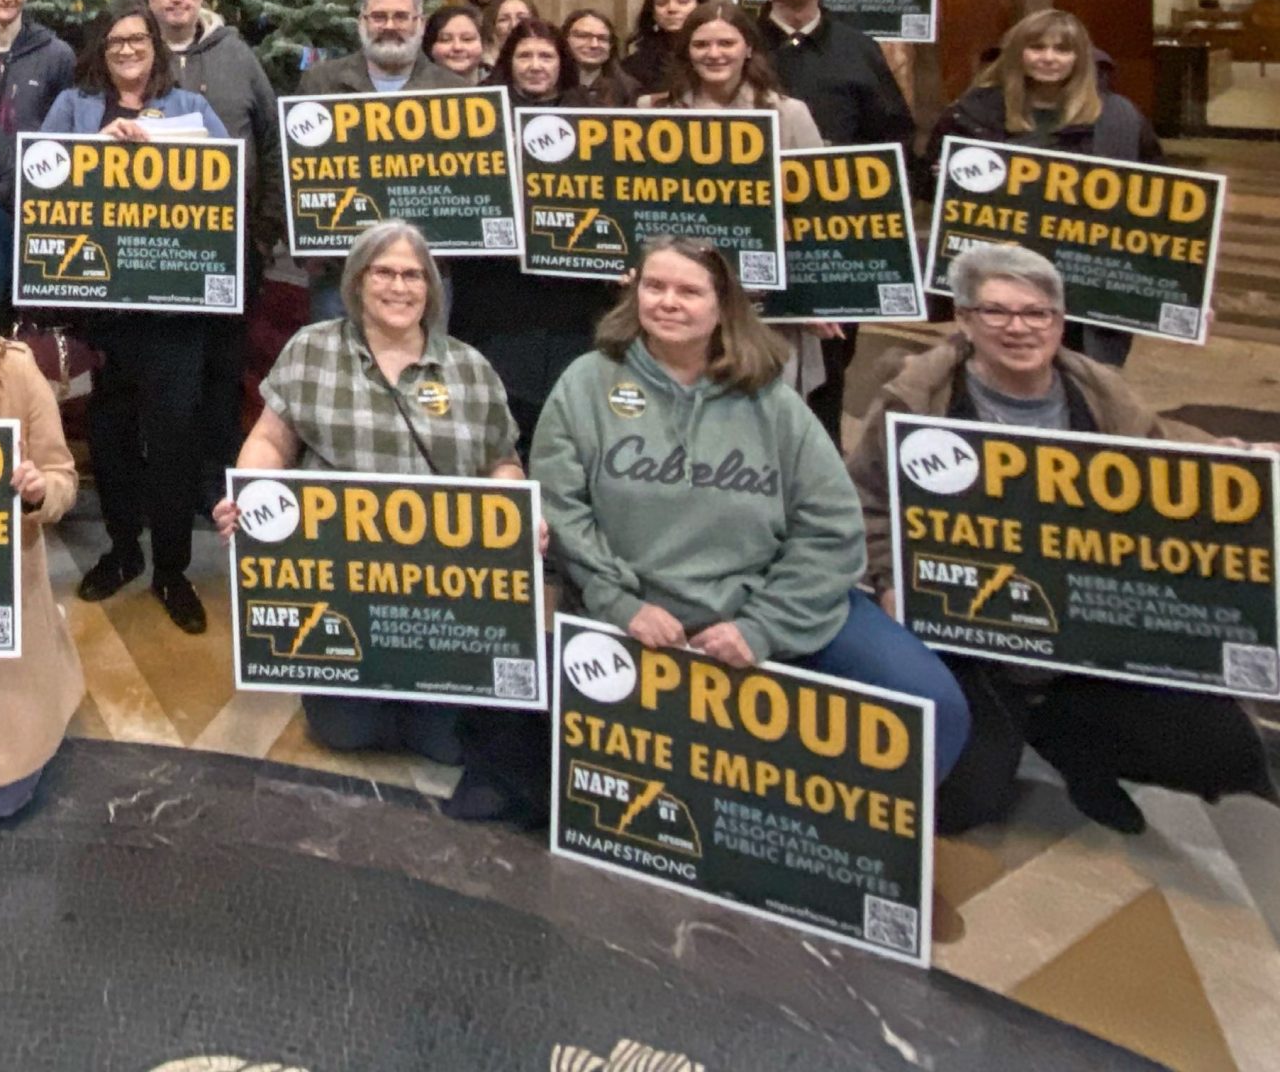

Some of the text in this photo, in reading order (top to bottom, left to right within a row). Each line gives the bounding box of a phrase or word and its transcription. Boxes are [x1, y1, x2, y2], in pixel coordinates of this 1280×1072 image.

[290, 112, 330, 140] I'M A
[334, 97, 497, 143] PROUD
[527, 126, 572, 154] I'M A
[578, 119, 765, 165] PROUD
[26, 152, 68, 180] I'M A
[73, 145, 231, 191] PROUD
[291, 151, 506, 181] STATE EMPLOYEE
[782, 156, 892, 203] OUD
[989, 159, 1003, 173] A
[526, 172, 771, 206] STATE EMPLOYEE
[1007, 156, 1208, 223] PROUD
[23, 199, 234, 231] STATE EMPLOYEE
[535, 211, 575, 228] NAPE
[785, 214, 905, 242] PLOYEE
[944, 198, 1207, 264] STATE EMPLOYEE
[29, 238, 65, 255] NAPE
[117, 236, 180, 248] NEBRASKA
[117, 248, 217, 261] ASSOCIATION OF
[117, 259, 157, 270] PUBLIC
[531, 254, 625, 270] #NAPESTRONG
[23, 283, 108, 297] #NAPESTRONG
[603, 434, 780, 498] Cabela's
[907, 446, 973, 480] I'M A
[983, 439, 1261, 524] PROUD
[241, 495, 295, 531] I'M A
[303, 486, 522, 548] PROUD
[905, 506, 1271, 584] STATE EMPLOYEE
[240, 555, 530, 601] STATE EMPLOYEE
[918, 560, 978, 588] NAPE
[251, 605, 300, 627] NAPE
[913, 620, 1054, 654] #NAPESTRONG
[248, 661, 360, 682] #NAPESTRONG
[569, 653, 632, 684] I'M A
[641, 650, 909, 769] PROUD
[564, 710, 916, 837] STATE EMPLOYEE
[574, 766, 629, 802] NAPE
[566, 827, 697, 880] #NAPESTRONG
